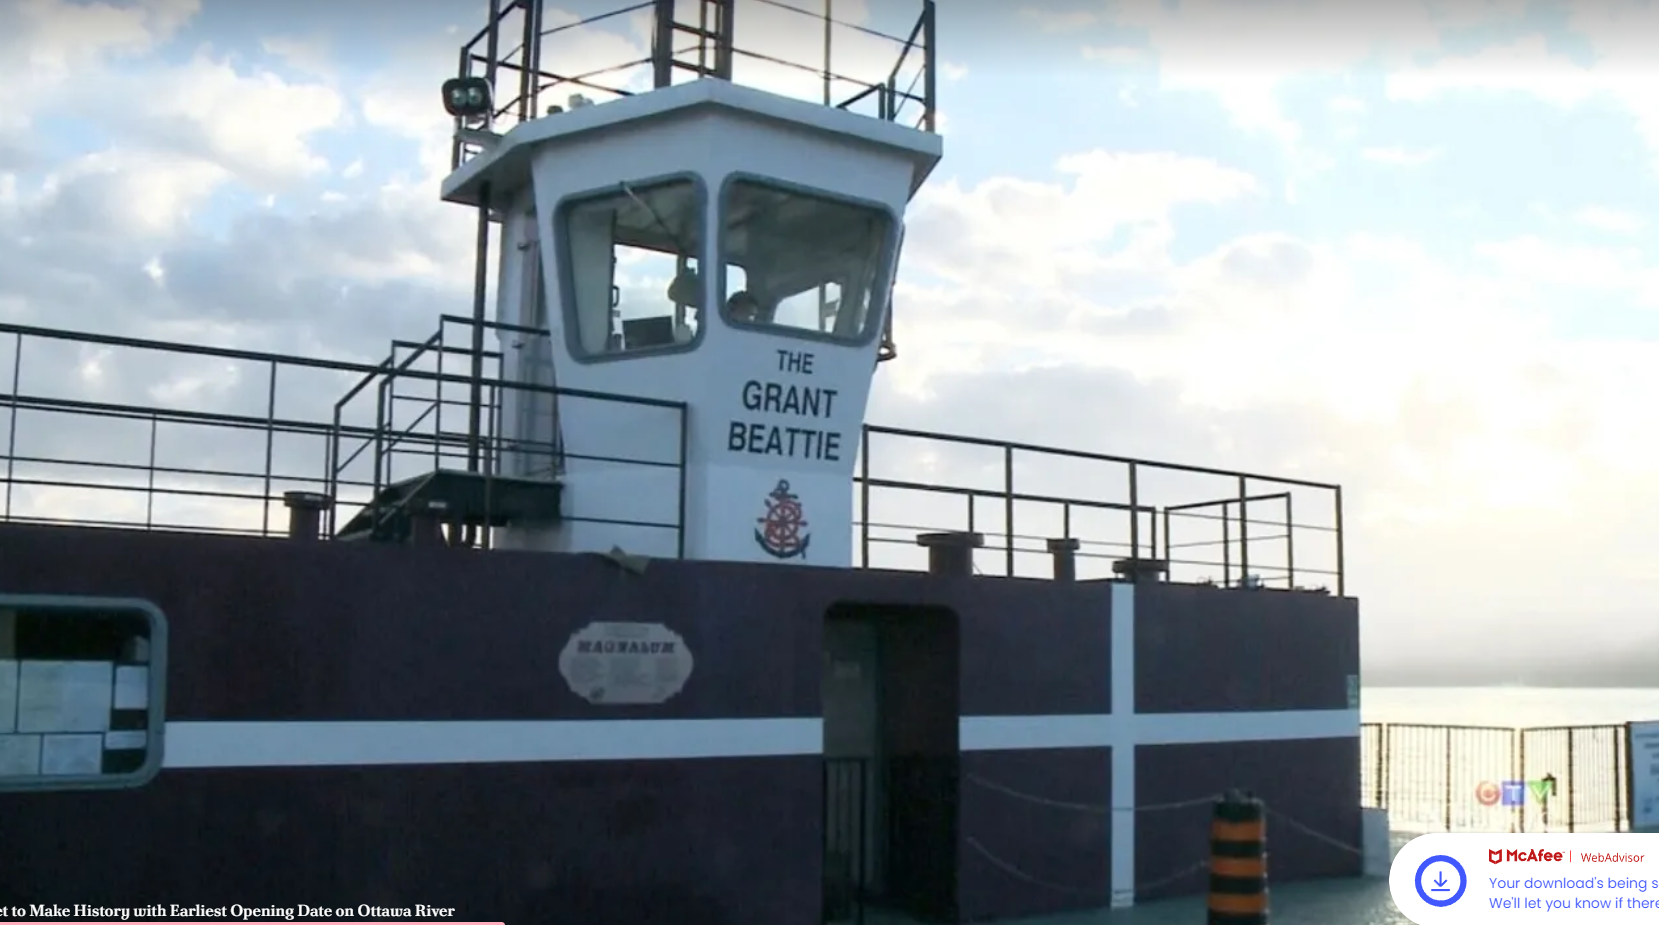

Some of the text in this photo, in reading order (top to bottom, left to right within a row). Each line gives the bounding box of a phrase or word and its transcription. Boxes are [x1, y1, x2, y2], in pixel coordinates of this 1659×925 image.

[777, 349, 814, 374] THE
[742, 379, 838, 418] GRANT
[727, 420, 841, 461] BEATTIE
